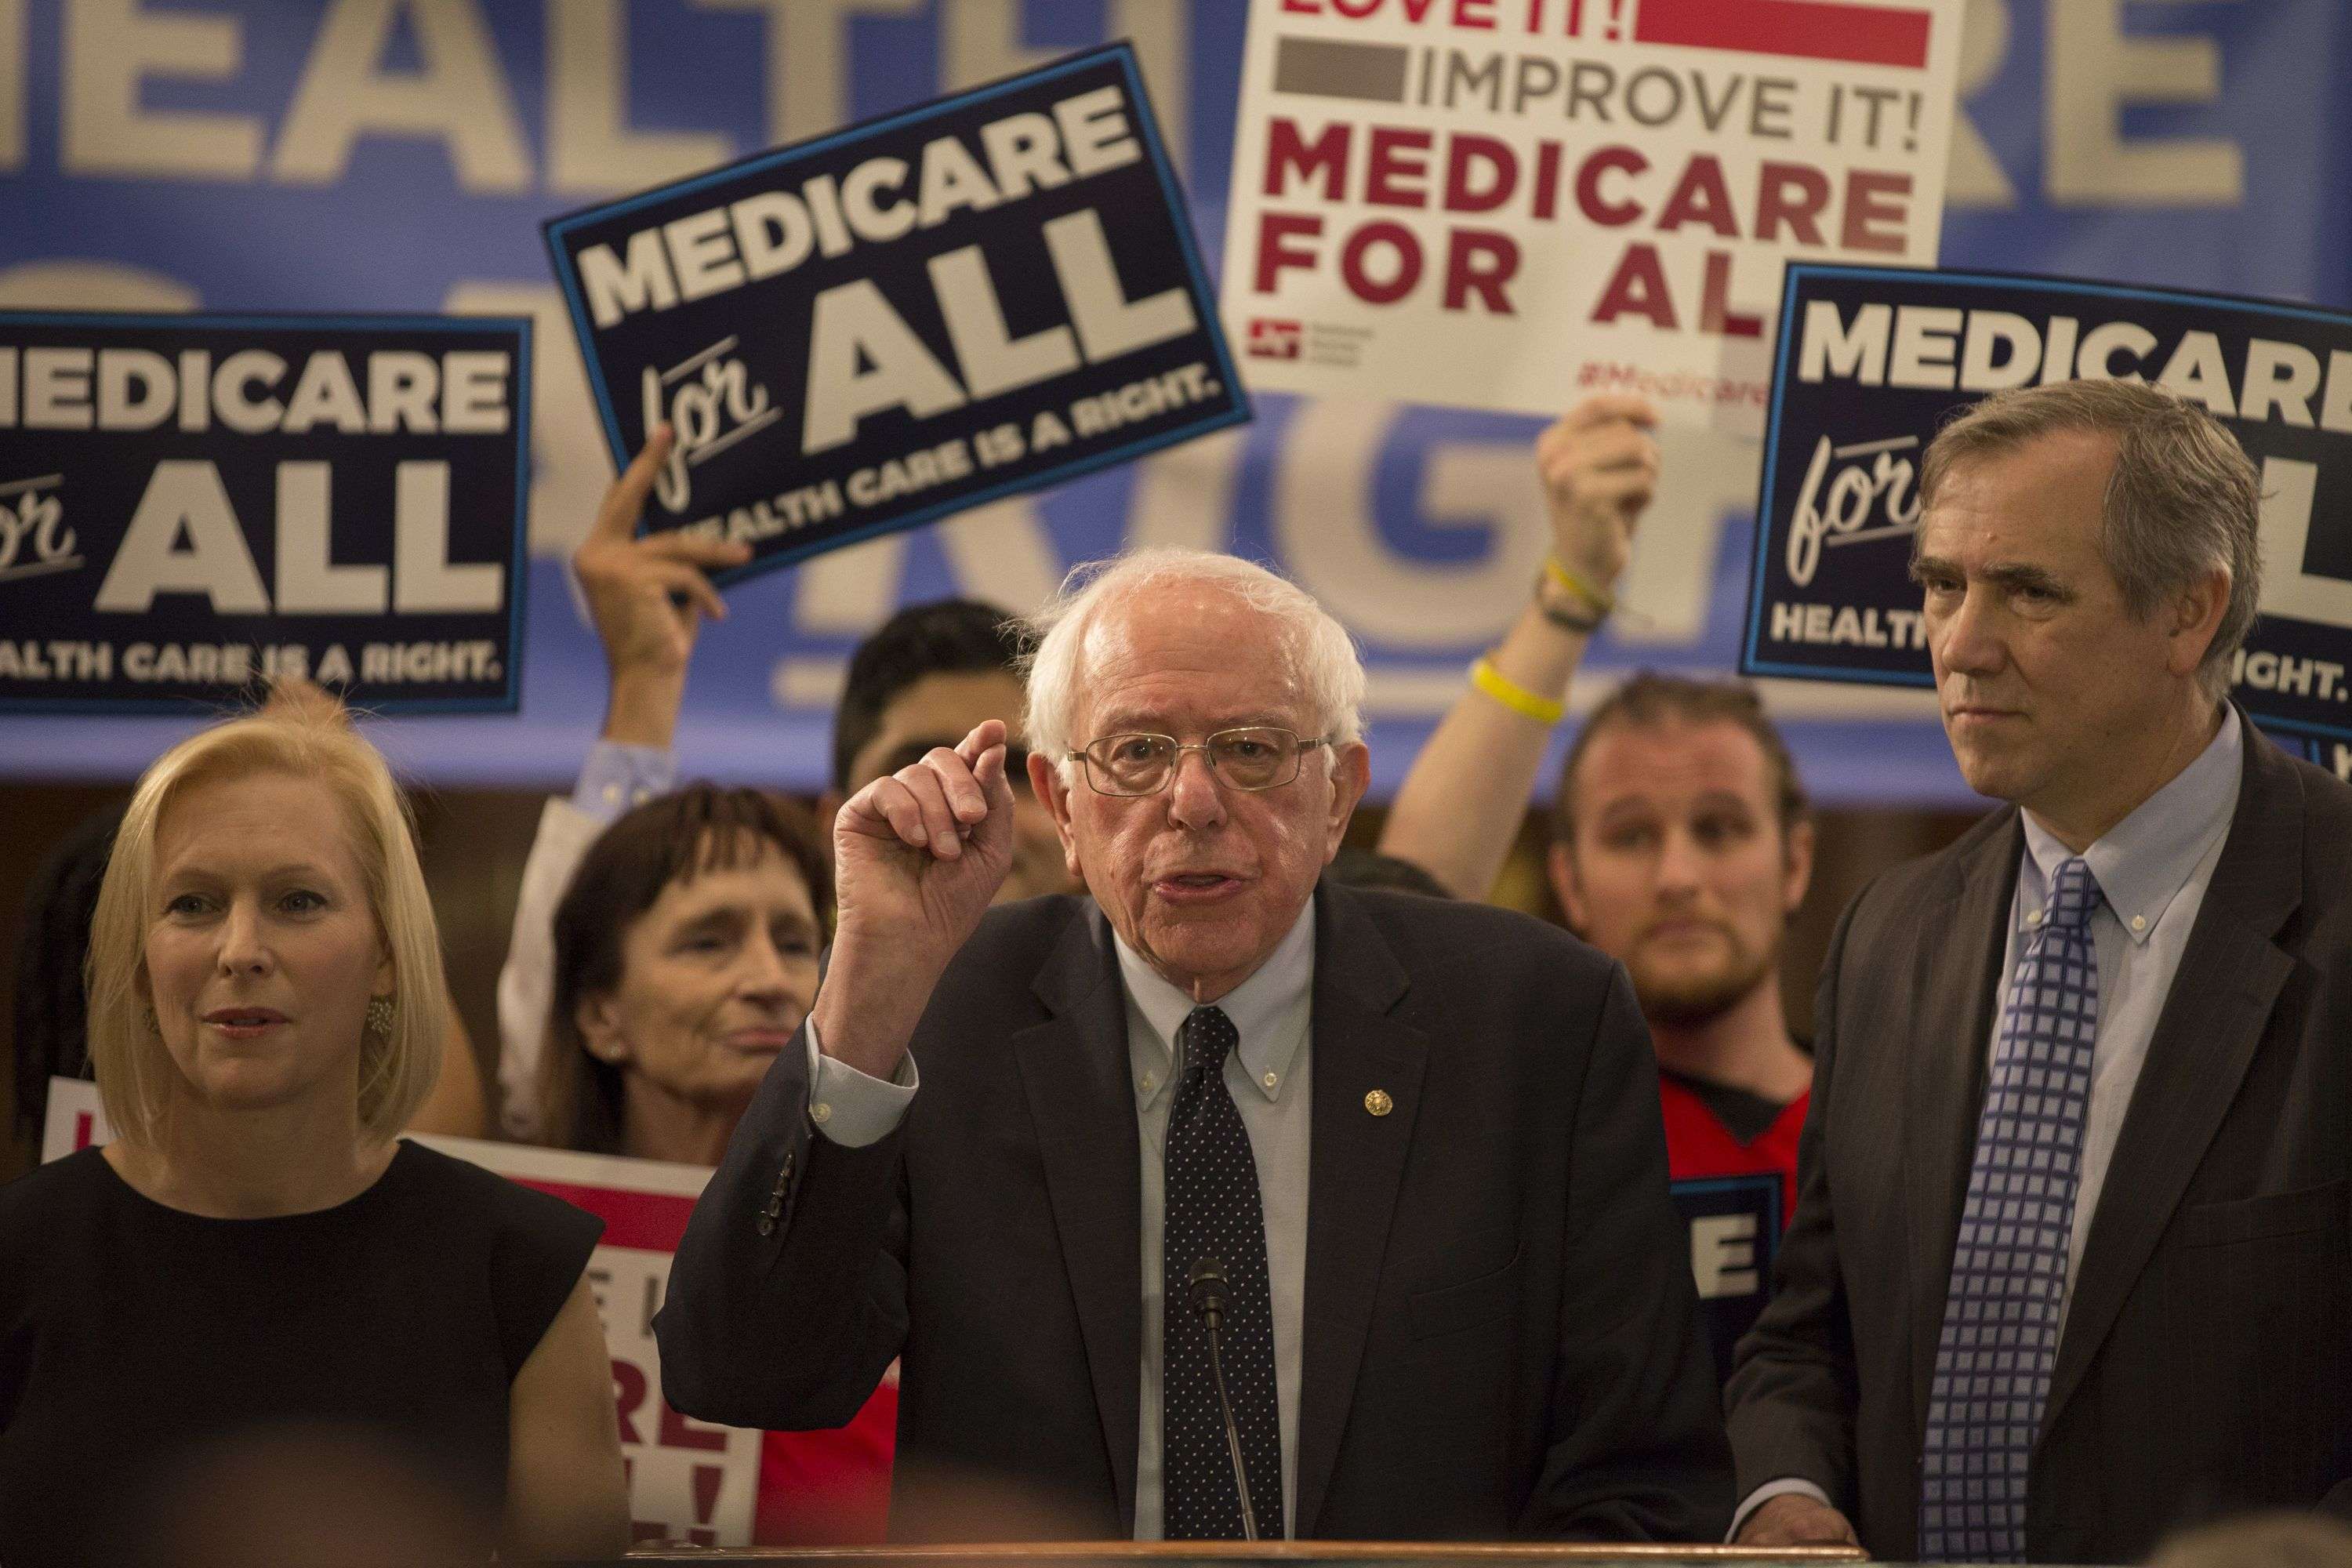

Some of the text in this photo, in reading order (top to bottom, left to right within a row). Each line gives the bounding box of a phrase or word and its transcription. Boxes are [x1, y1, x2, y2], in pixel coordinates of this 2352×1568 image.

[0, 0, 1185, 200] EALTH
[1417, 45, 1924, 152] IMPROVE IT!
[577, 85, 1143, 328] MEDICARE
[1261, 115, 1916, 256] MEDICARE
[800, 207, 1199, 456] ALL
[1253, 210, 1523, 317] FOR
[0, 347, 510, 434] EDICARE
[679, 361, 1225, 543] EALTH CARE IS A RIGHT.
[91, 458, 506, 615] ALL
[1784, 434, 1921, 588] for
[121, 641, 252, 684] CARE
[316, 643, 355, 682] A
[360, 638, 505, 684] RIGHT.
